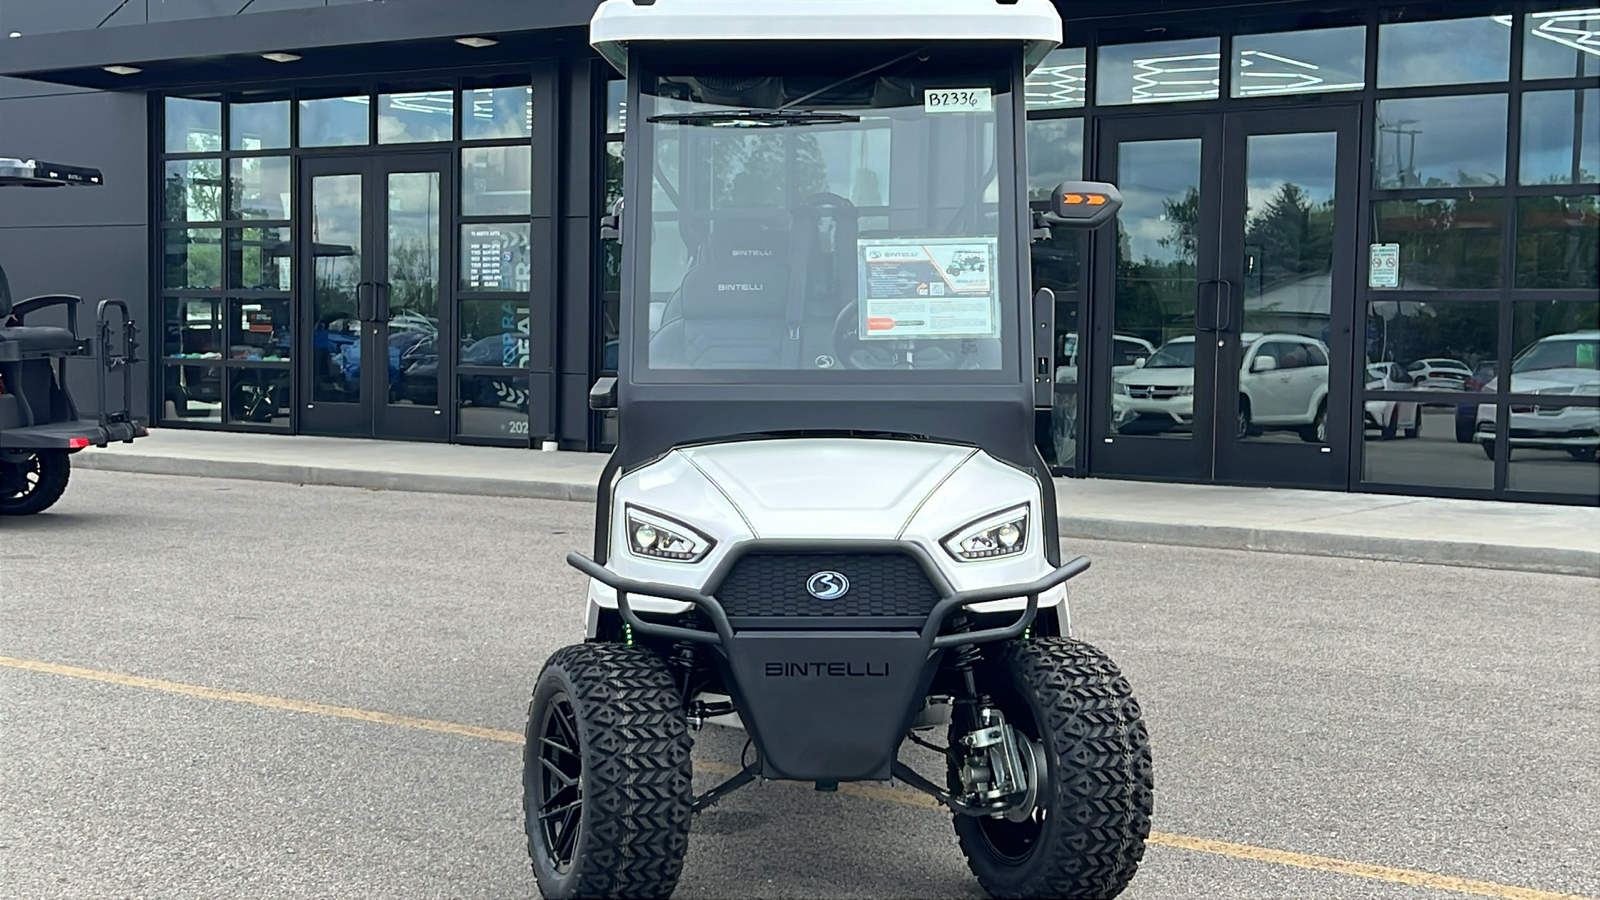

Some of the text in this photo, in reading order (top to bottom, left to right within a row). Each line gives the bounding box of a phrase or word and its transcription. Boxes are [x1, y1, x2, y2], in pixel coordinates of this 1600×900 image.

[929, 92, 978, 107] B2336
[717, 283, 763, 291] BINTELLI
[765, 662, 889, 677] BINTELLI
